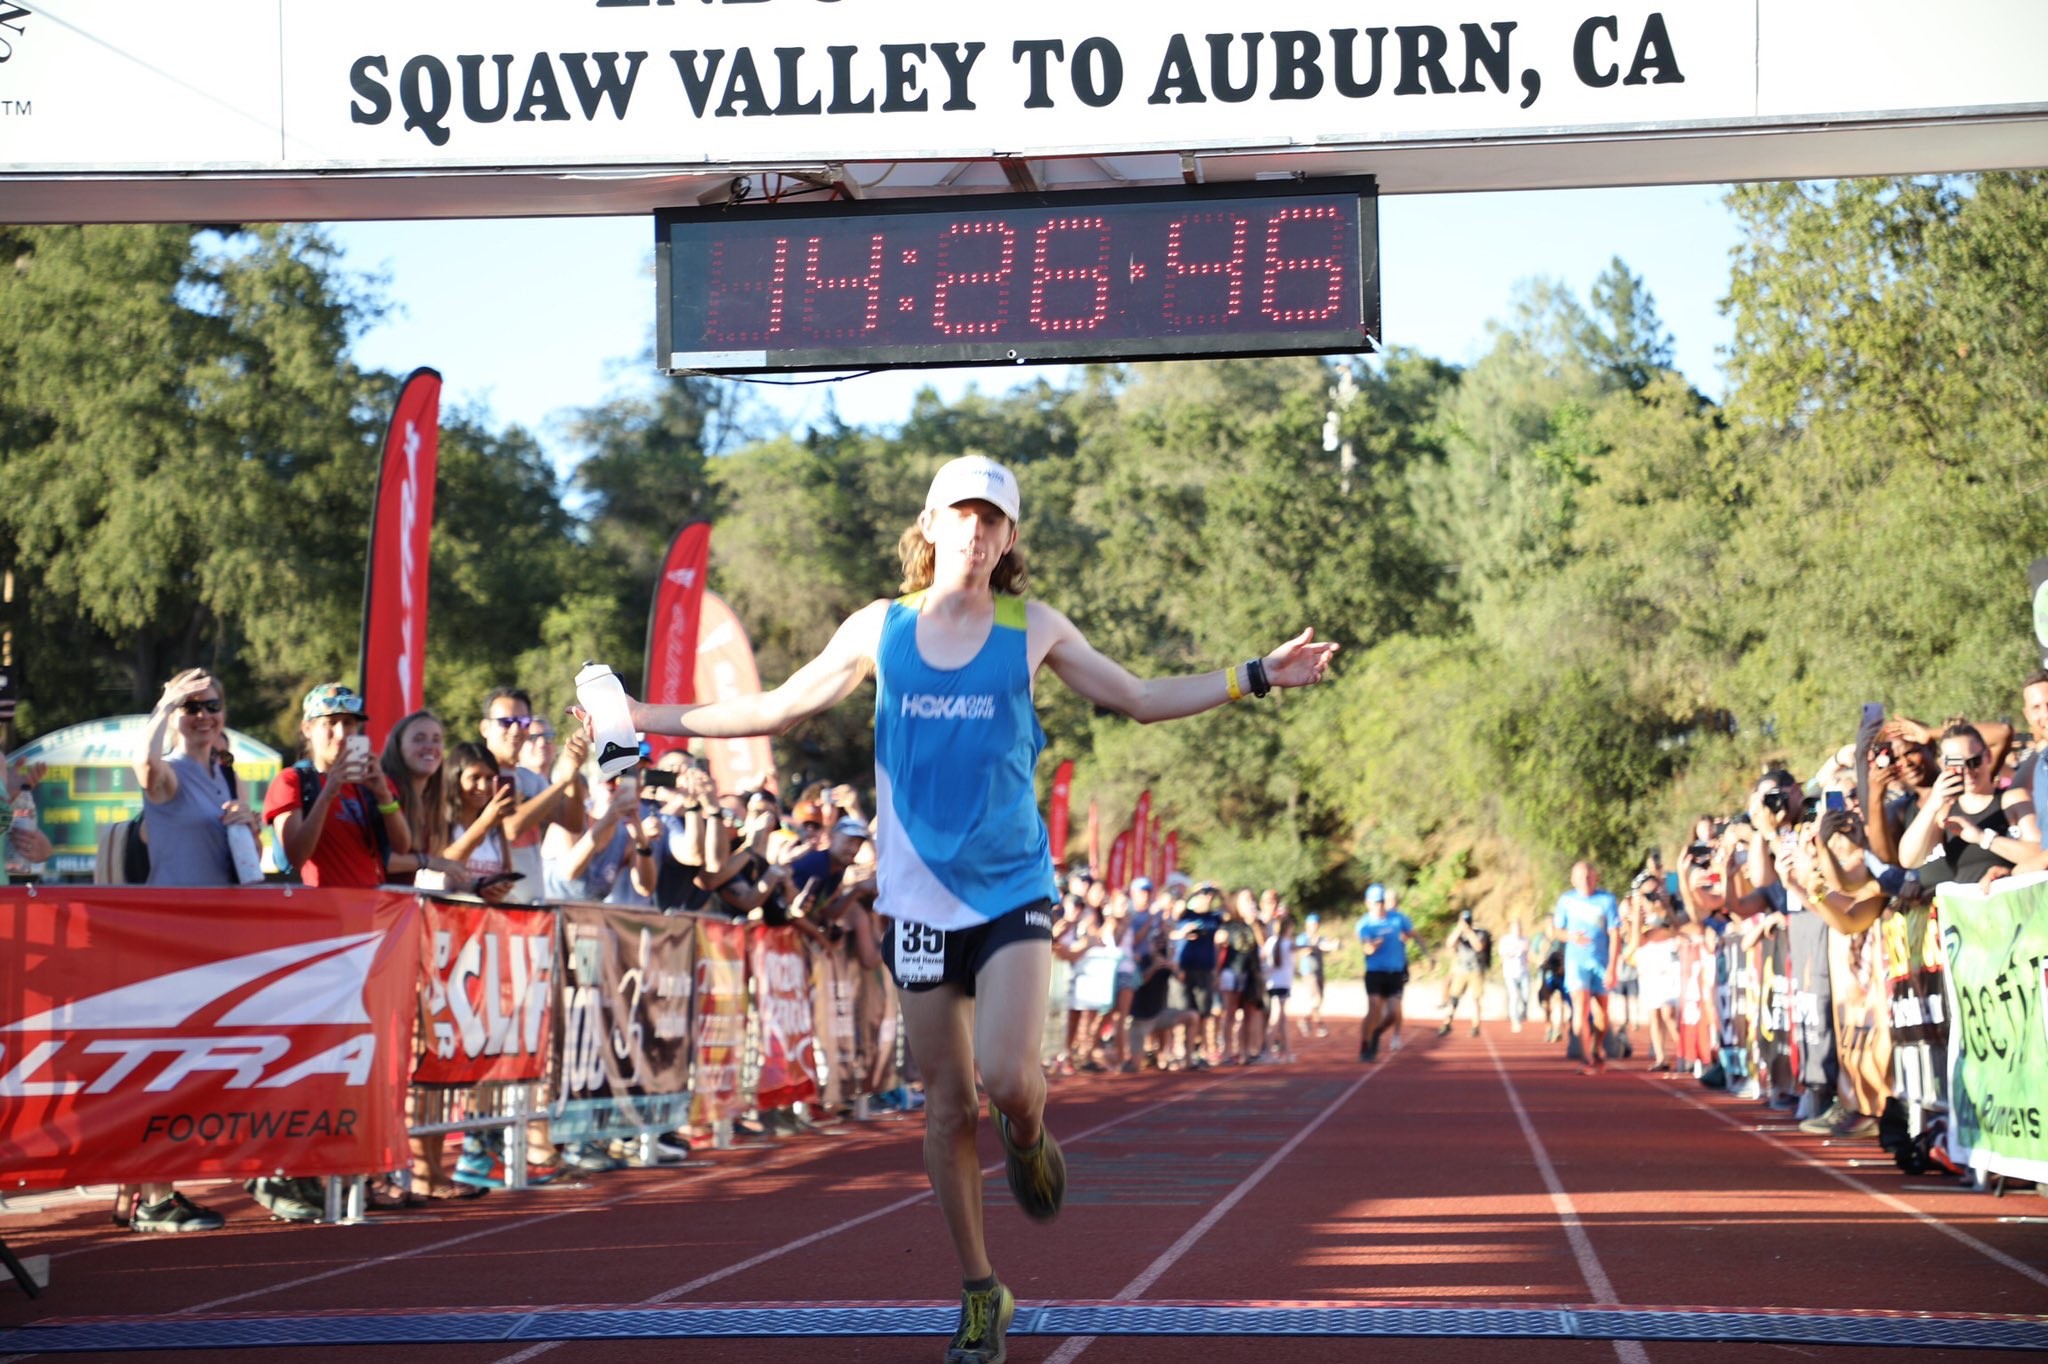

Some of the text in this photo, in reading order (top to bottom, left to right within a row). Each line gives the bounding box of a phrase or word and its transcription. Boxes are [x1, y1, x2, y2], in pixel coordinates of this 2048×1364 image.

[349, 12, 1686, 147] SQUAW VALLEY TO AUBURN, CA
[1, 100, 32, 115] TM
[901, 693, 968, 719] HOKA
[902, 921, 943, 954] 35
[0, 1034, 377, 1096] LTRA
[142, 1109, 357, 1143] FOOTWEAR
